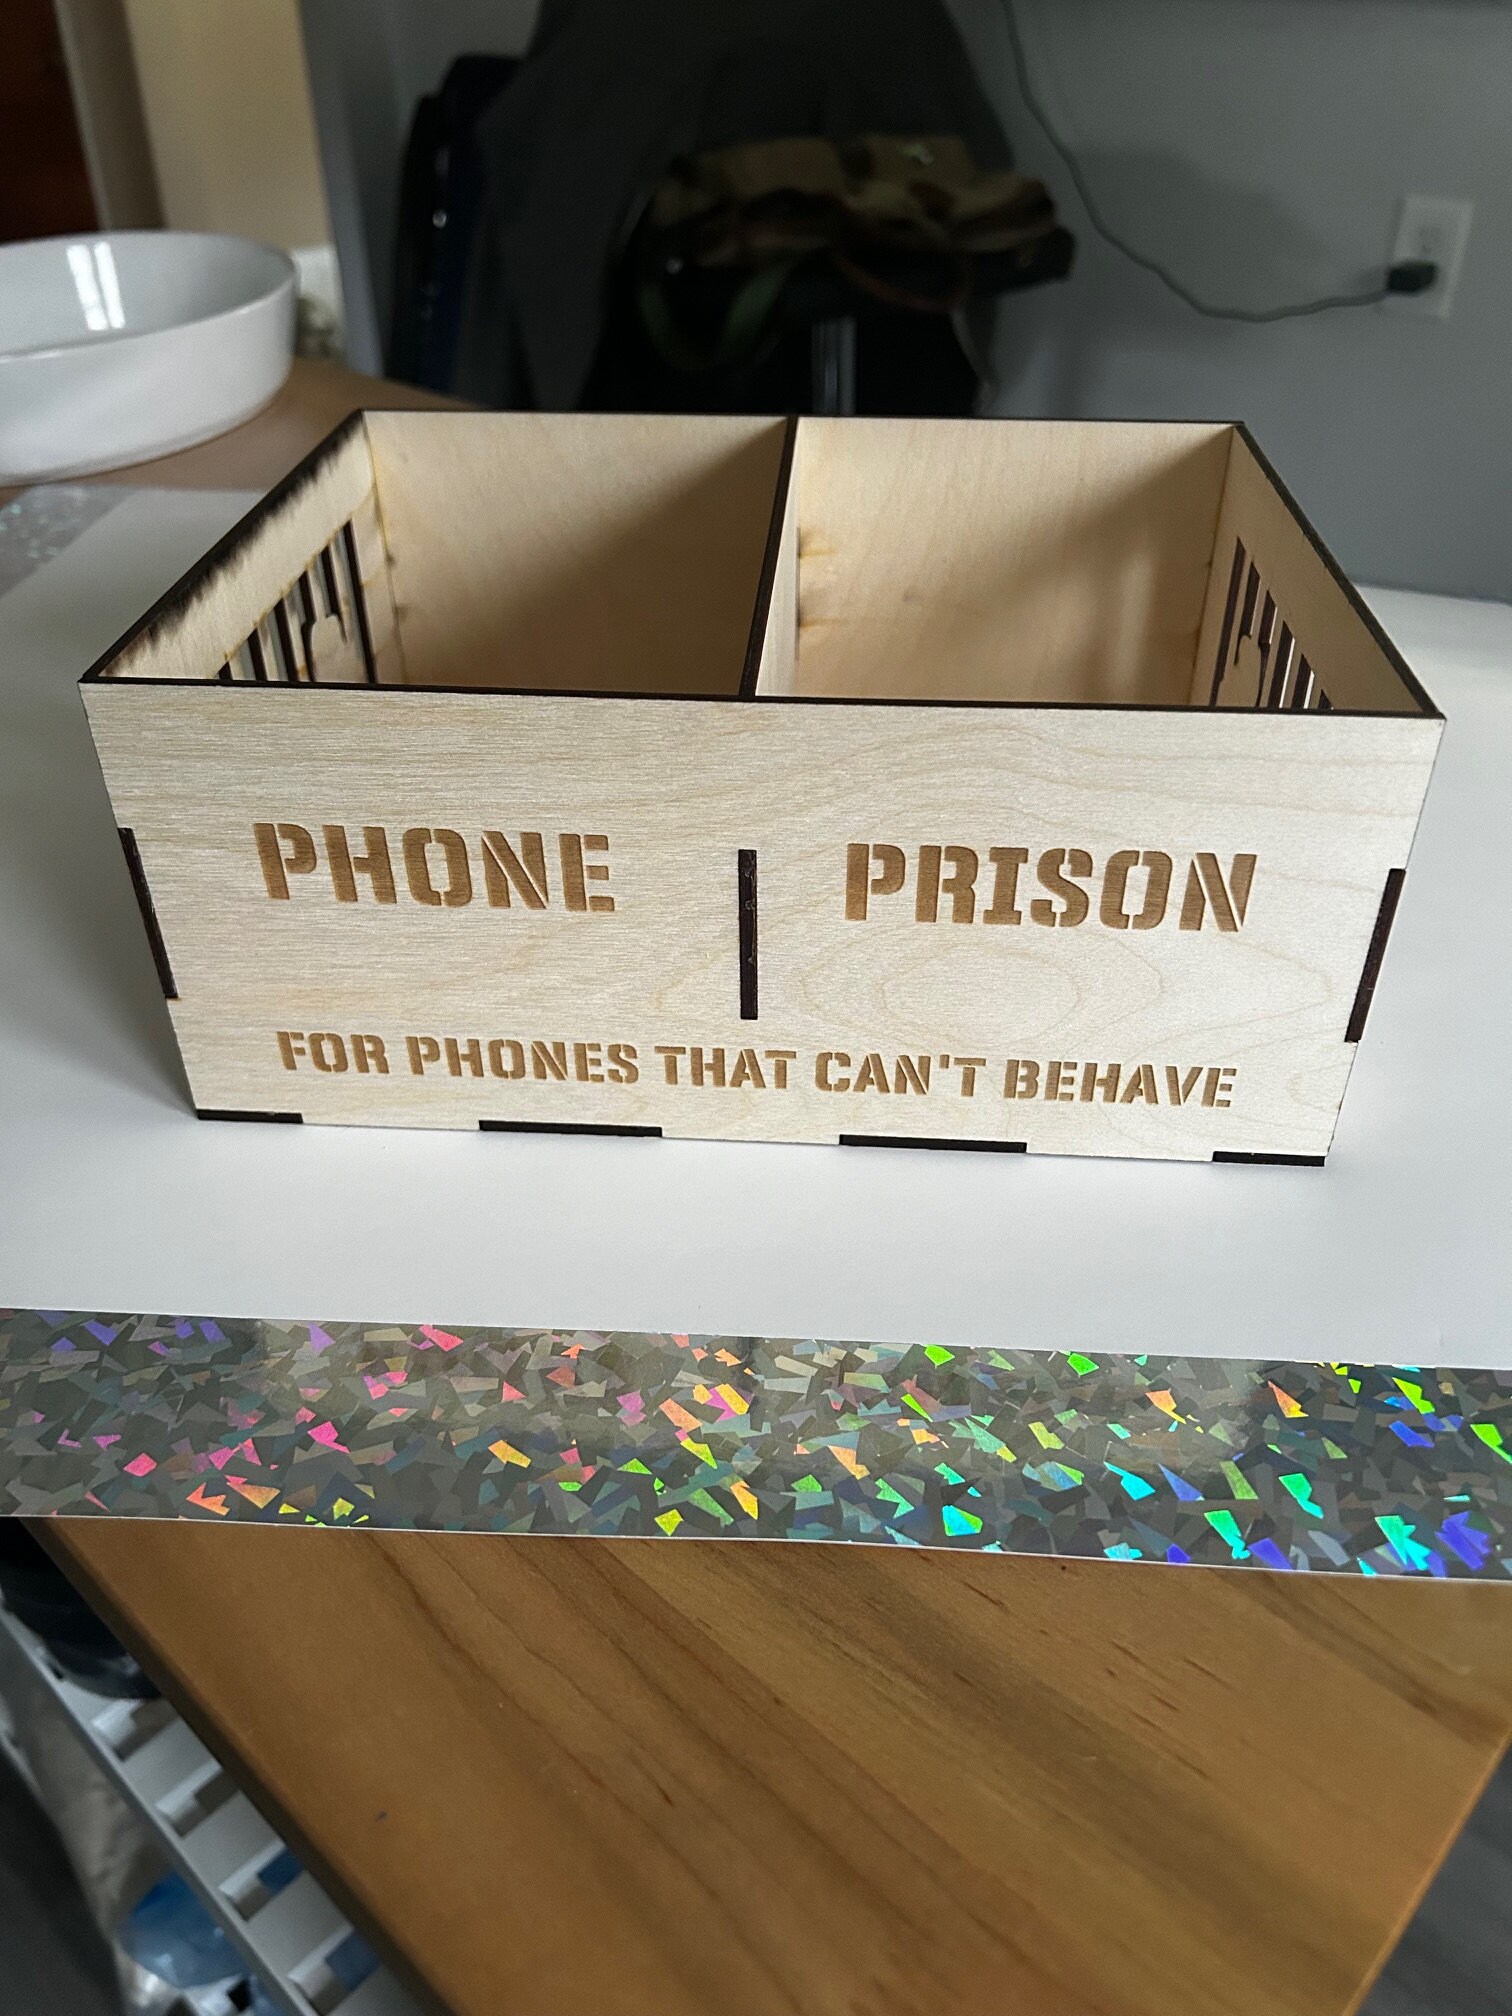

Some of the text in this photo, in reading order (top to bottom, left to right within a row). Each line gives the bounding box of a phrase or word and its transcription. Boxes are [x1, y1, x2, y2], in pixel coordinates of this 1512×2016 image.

[252, 822, 1257, 932] PHONE PRISON
[276, 1031, 1238, 1108] FOR PHONES THAT CAN'T BEHAVE
